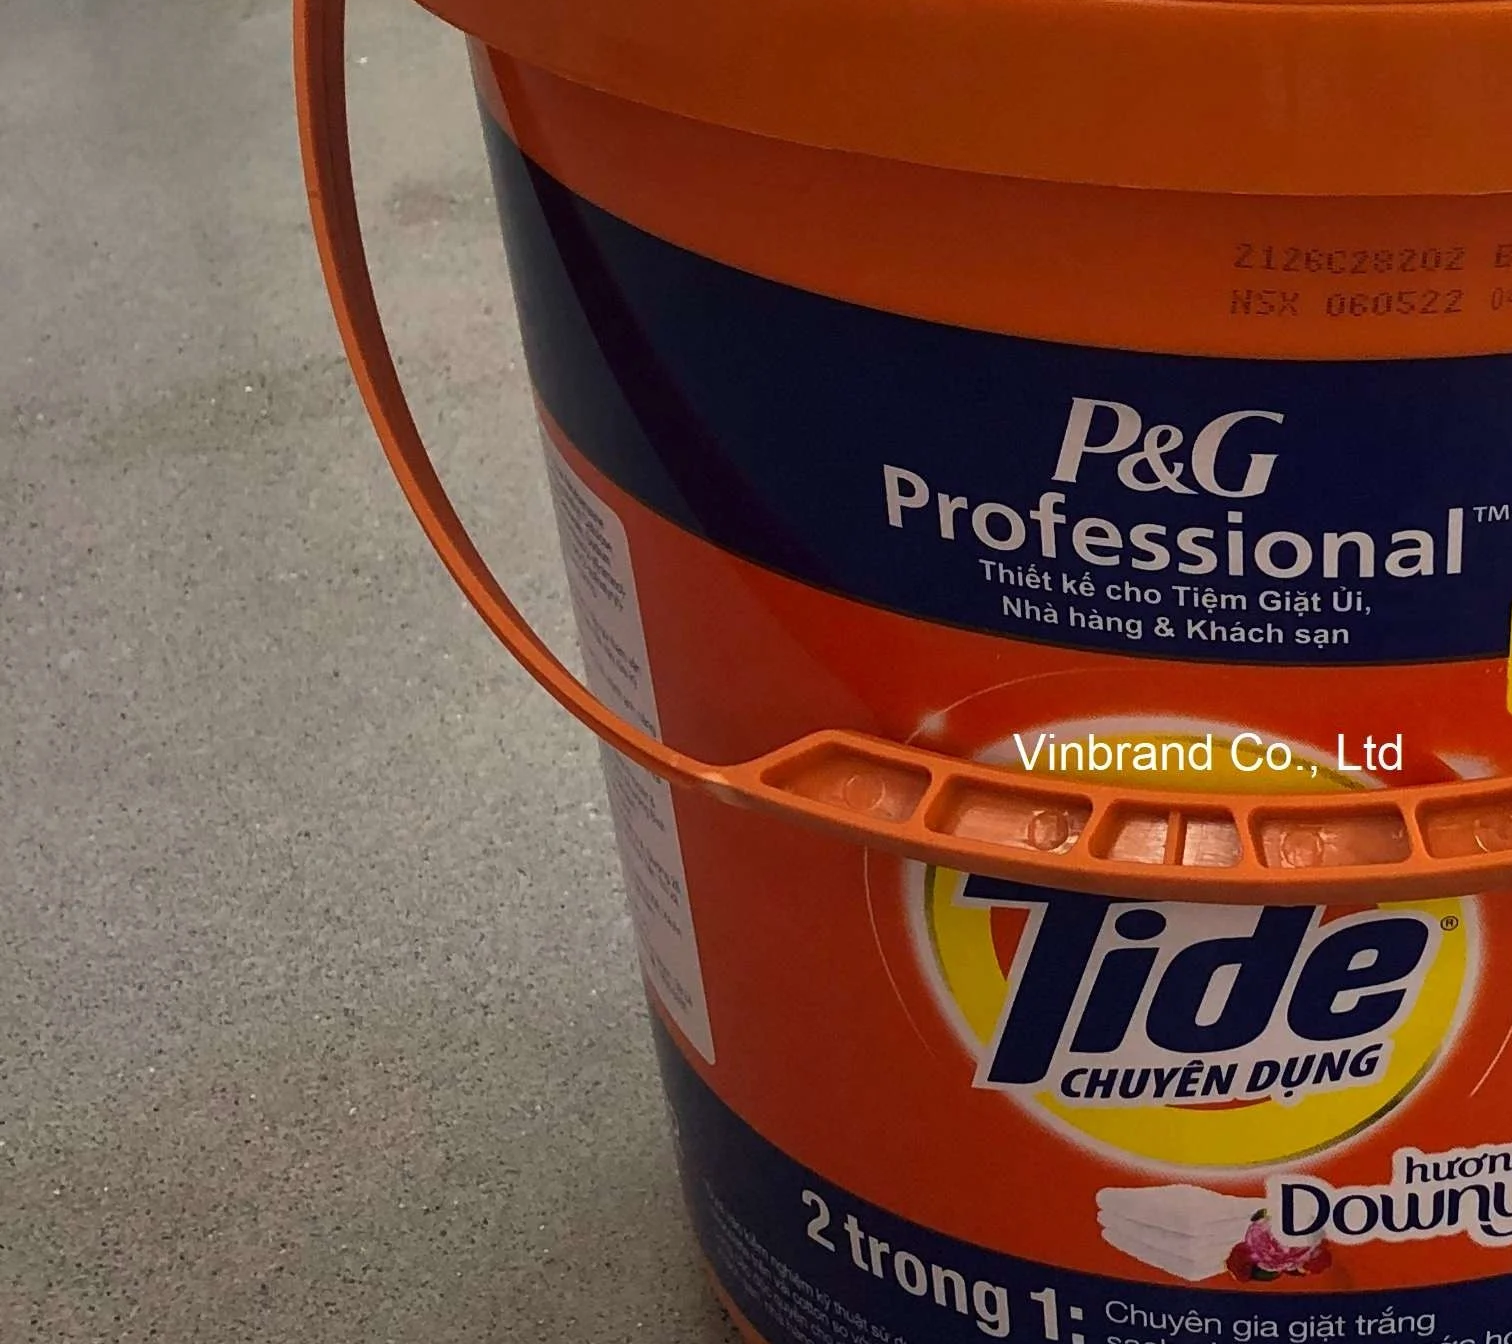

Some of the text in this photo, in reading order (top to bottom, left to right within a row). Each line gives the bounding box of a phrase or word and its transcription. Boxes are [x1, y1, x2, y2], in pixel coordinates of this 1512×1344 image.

[1231, 289, 1299, 316] NSX
[1326, 289, 1464, 317] 060522
[1052, 396, 1285, 498] P&G
[883, 464, 1464, 578] Professional
[979, 558, 1372, 617] Thiết kế cho Tiệm Giặt Ủi,
[1002, 595, 1351, 649] Nhà hàng & Khách sạn
[1060, 1043, 1384, 1100] CHUYÊN DỤNG
[801, 1189, 836, 1253] 2
[844, 1214, 1011, 1339] trong
[1105, 1300, 1437, 1343] Chuyên gia giặt trắng
